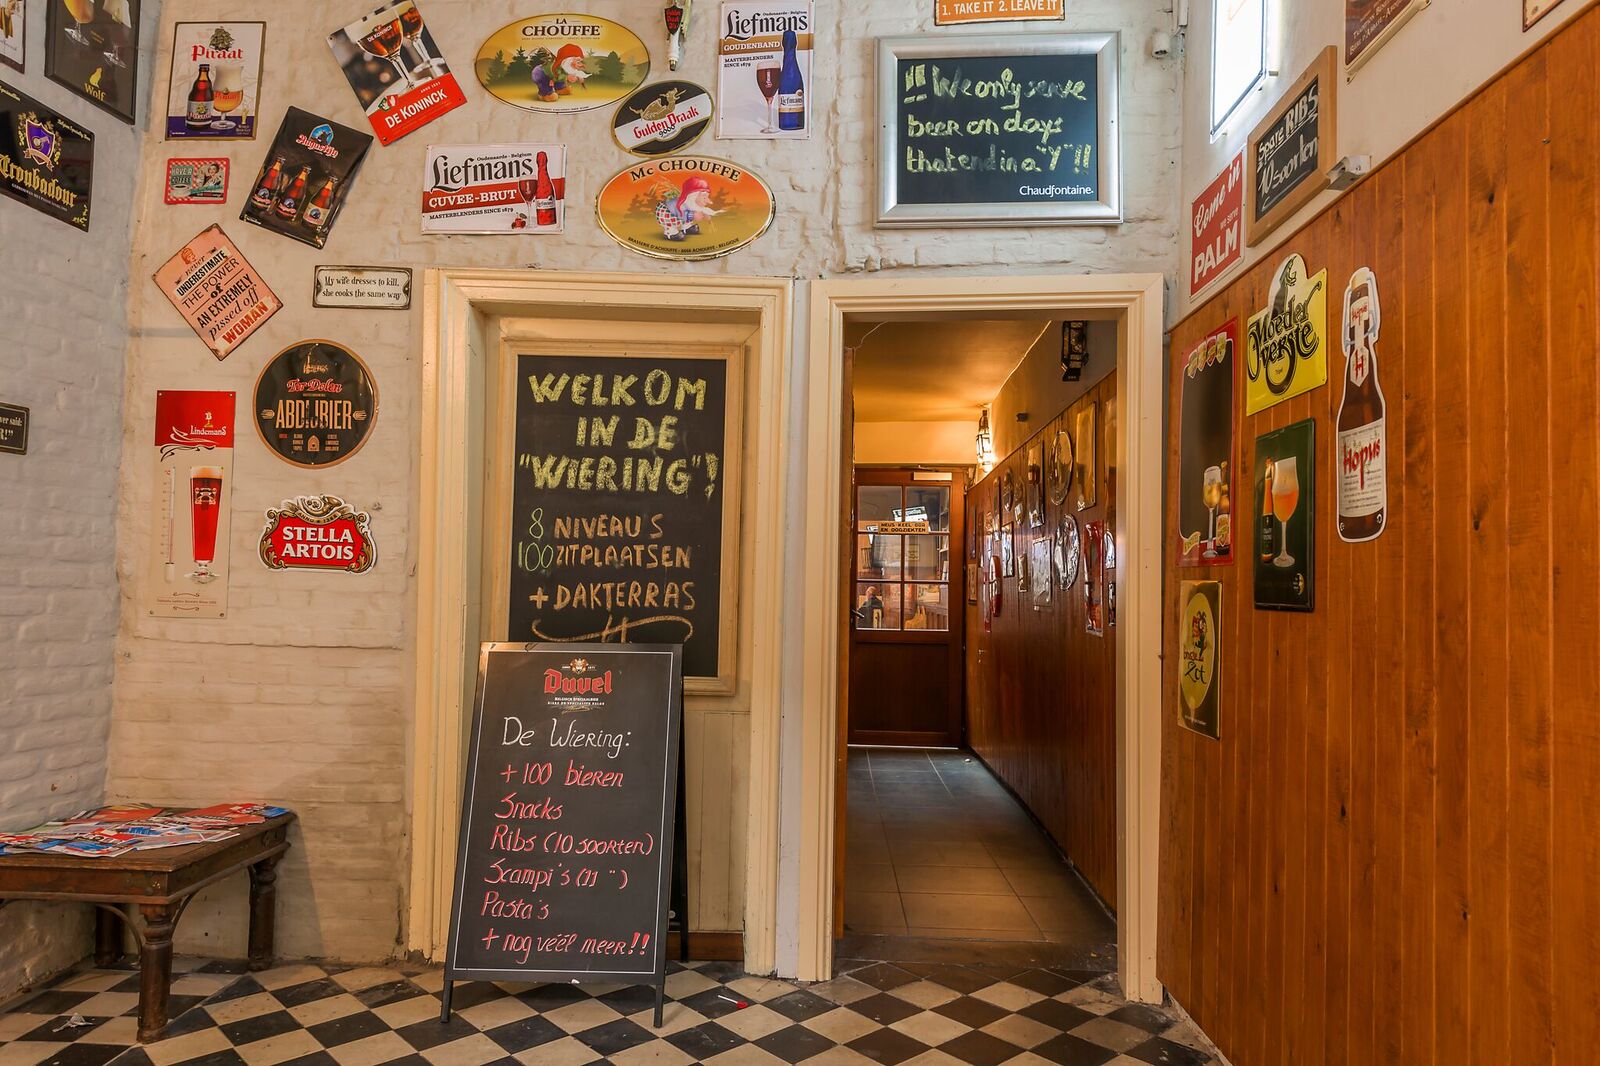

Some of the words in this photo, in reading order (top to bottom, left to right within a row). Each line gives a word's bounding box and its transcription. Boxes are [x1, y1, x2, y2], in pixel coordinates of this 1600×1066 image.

[942, 5, 951, 16] 1.
[954, 2, 980, 14] TAKE
[983, 1, 994, 12] IT
[998, 0, 1008, 12] 2.
[1011, 0, 1044, 11] LEAVE
[1047, 0, 1058, 10] IT
[522, 25, 601, 37] CHOUFFE
[724, 10, 808, 40] Liefmans
[191, 44, 244, 62] Piraat
[723, 41, 781, 51] GOUDENBAND
[724, 54, 774, 63] MASTERBLENDERS
[84, 82, 106, 102] Wolf
[932, 64, 973, 98] We
[974, 67, 1022, 111] only
[1024, 79, 1087, 100] serve
[385, 113, 402, 129] DE
[399, 88, 448, 120] KONINCK
[633, 121, 669, 139] Gulden
[666, 106, 699, 127] Draak
[1258, 125, 1285, 159] Spare
[1284, 84, 1319, 137] RIBS
[658, 124, 676, 137] 9000
[966, 118, 1000, 136] on
[296, 133, 339, 159] Augustijn
[476, 153, 508, 161] Oudenaarde
[906, 145, 958, 174] that
[999, 149, 1018, 174] in
[1021, 157, 1042, 173] a
[430, 155, 534, 193] Liefmans
[630, 164, 655, 182] Mc
[658, 159, 742, 183] CHOUFFE
[1258, 159, 1275, 198] 10
[1272, 133, 1318, 186] soorten
[429, 189, 517, 208] CUVEE-BRUT
[1193, 183, 1227, 238] Come
[1227, 158, 1241, 195] in
[429, 210, 484, 220] MASTERBLENDERS
[185, 255, 205, 277] never
[1193, 220, 1240, 285] PALM
[176, 250, 229, 297] UNDERESTIMATE
[182, 290, 204, 309] THE
[201, 258, 240, 293] POWER
[324, 276, 335, 287] My
[336, 276, 350, 285] wife
[351, 276, 377, 286] dresses
[378, 278, 385, 287] to
[196, 310, 212, 329] AN
[208, 273, 254, 318] EXTREMELY
[210, 282, 224, 299] of
[322, 288, 333, 297] she
[334, 289, 354, 298] cooks
[354, 288, 366, 298] the
[387, 291, 402, 301] way
[208, 299, 243, 342] pissed
[243, 283, 260, 308] off
[222, 301, 270, 345] WOMAN
[1249, 289, 1315, 350] Moeder
[528, 368, 707, 411] WELKOM
[575, 414, 620, 448] IN
[627, 414, 679, 450] DE
[1343, 438, 1381, 490] Hopus
[282, 526, 354, 543] STELLA
[528, 507, 545, 539] 8
[281, 543, 355, 560] ARTOIS
[517, 541, 554, 572] 100
[555, 544, 693, 569] ZITPLAATSEN
[553, 580, 696, 611] DAKTERRAS
[543, 668, 613, 695] Duvel
[501, 716, 535, 748] De
[522, 762, 553, 785] 100
[494, 792, 563, 820] Snacks
[490, 823, 537, 852] Ribs
[543, 831, 574, 854] (10
[575, 867, 599, 888] (11
[502, 933, 532, 965] nog
